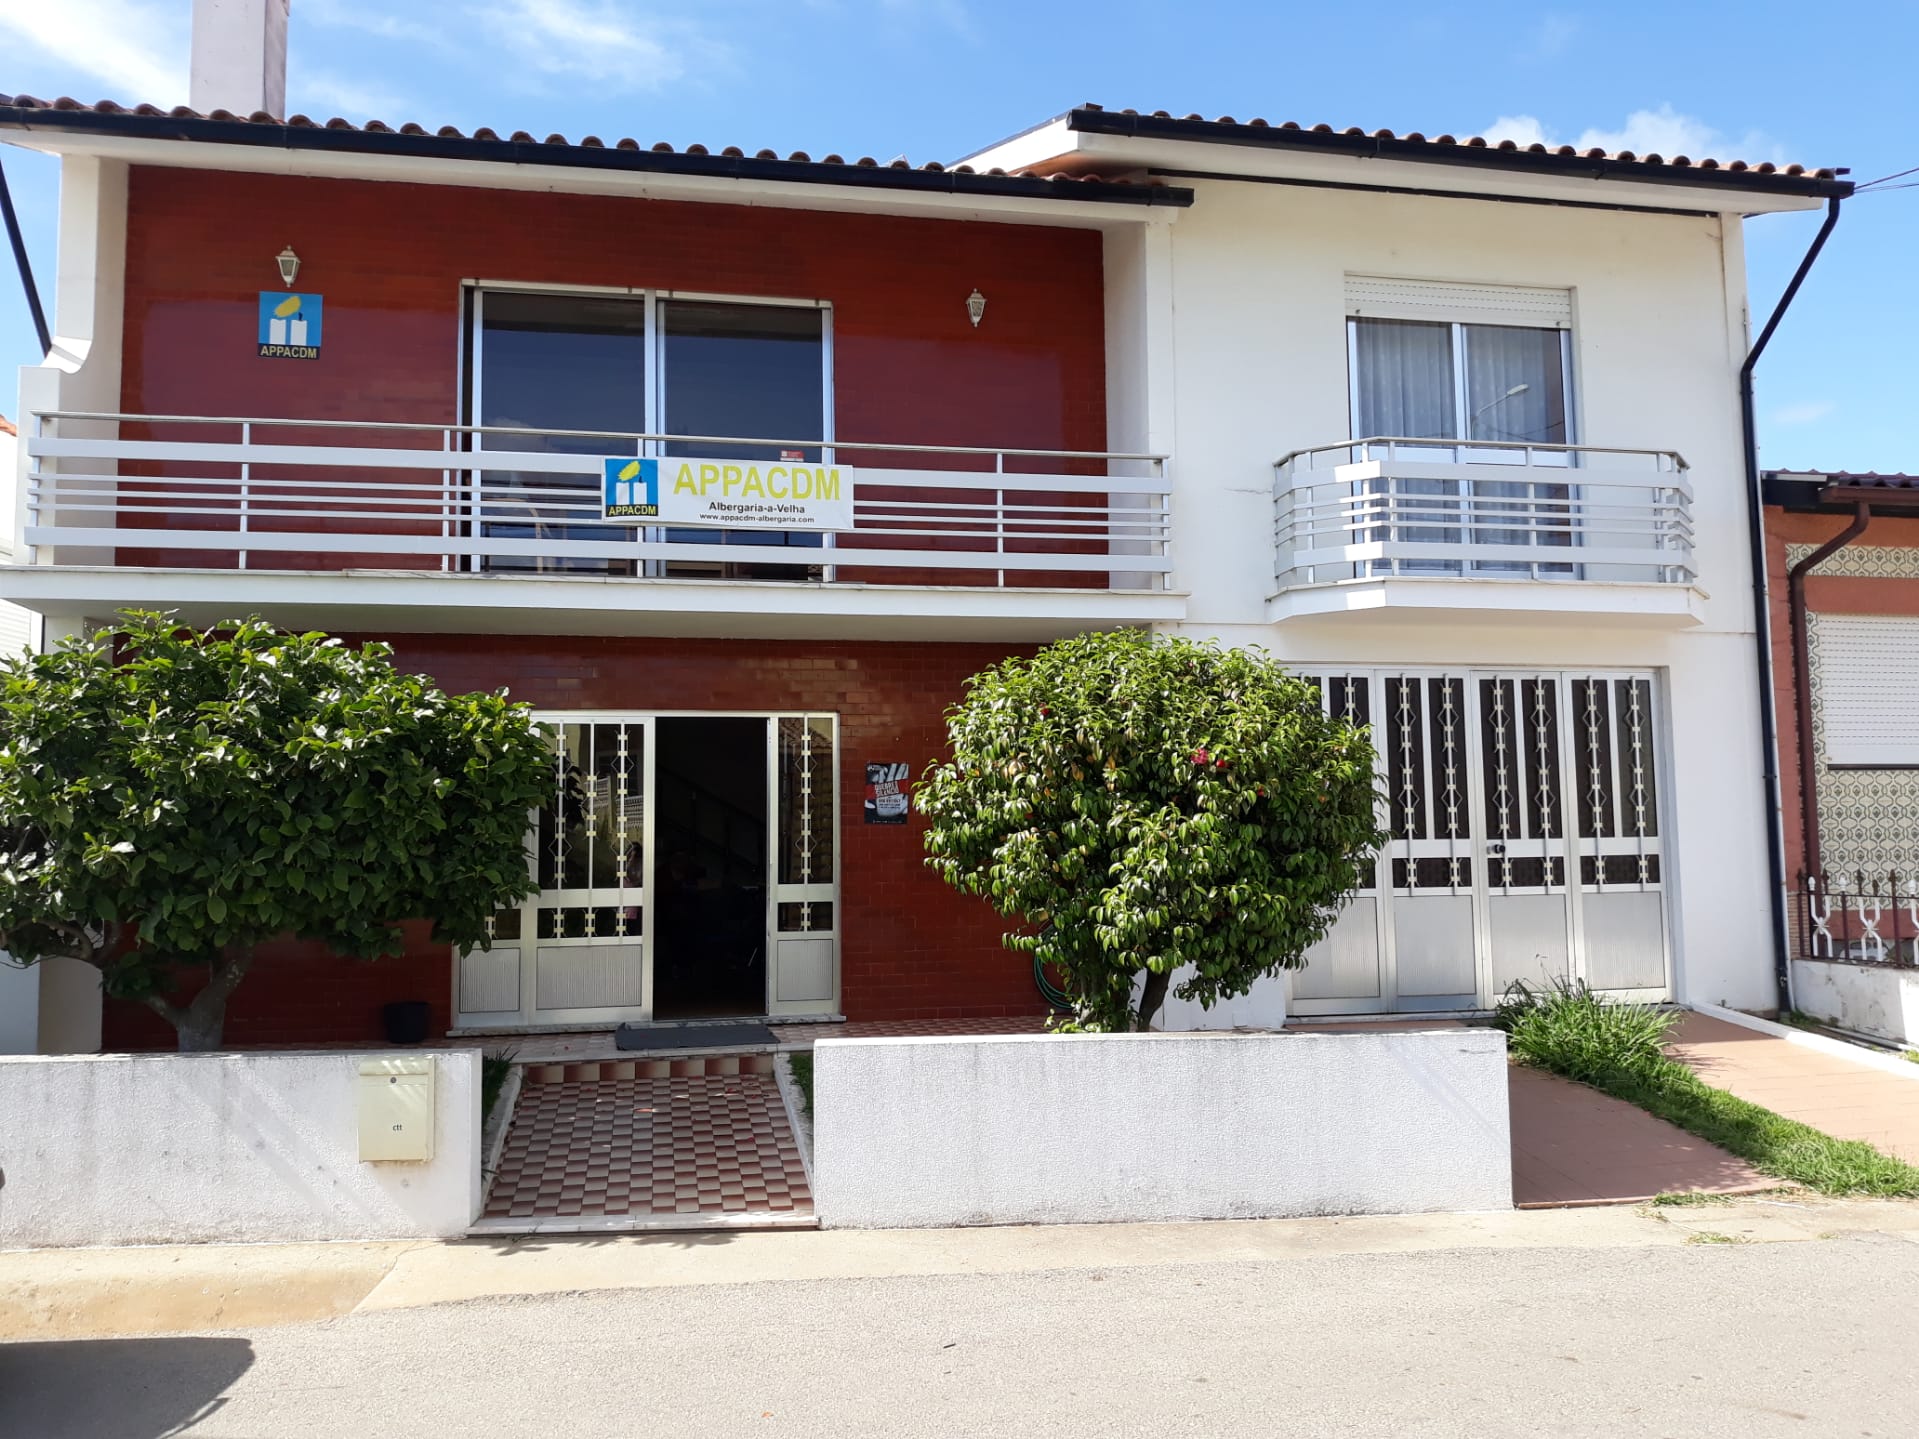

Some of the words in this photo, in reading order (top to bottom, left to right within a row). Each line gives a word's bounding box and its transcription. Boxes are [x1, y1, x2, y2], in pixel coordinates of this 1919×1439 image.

[260, 346, 317, 358] APPACDM
[673, 463, 840, 501] APPACDM
[608, 505, 656, 517] APPACDM
[709, 502, 805, 515] Albergaria-a-Velha
[699, 513, 815, 524] www.appacdm-albergaria.com
